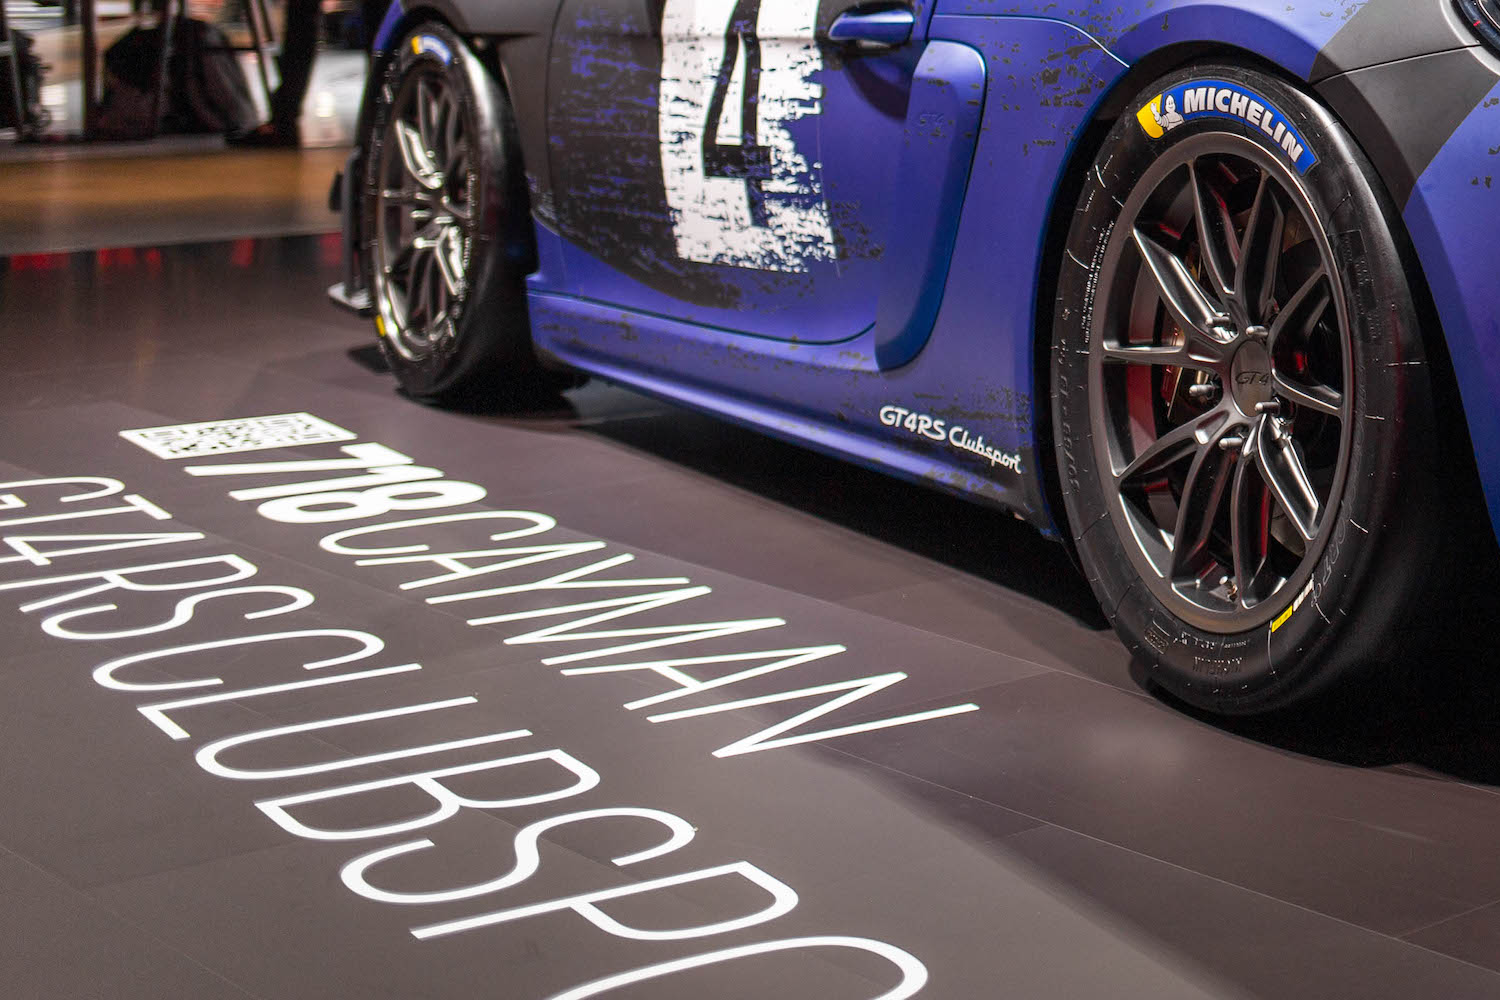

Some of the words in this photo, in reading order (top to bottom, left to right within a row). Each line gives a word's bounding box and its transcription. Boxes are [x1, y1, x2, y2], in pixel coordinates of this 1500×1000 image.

[1183, 86, 1304, 164] MICHELIN
[879, 404, 947, 442] GT4RS
[948, 425, 1023, 475] Clubsport
[184, 442, 488, 524] 718
[318, 509, 981, 758] CAYMAN
